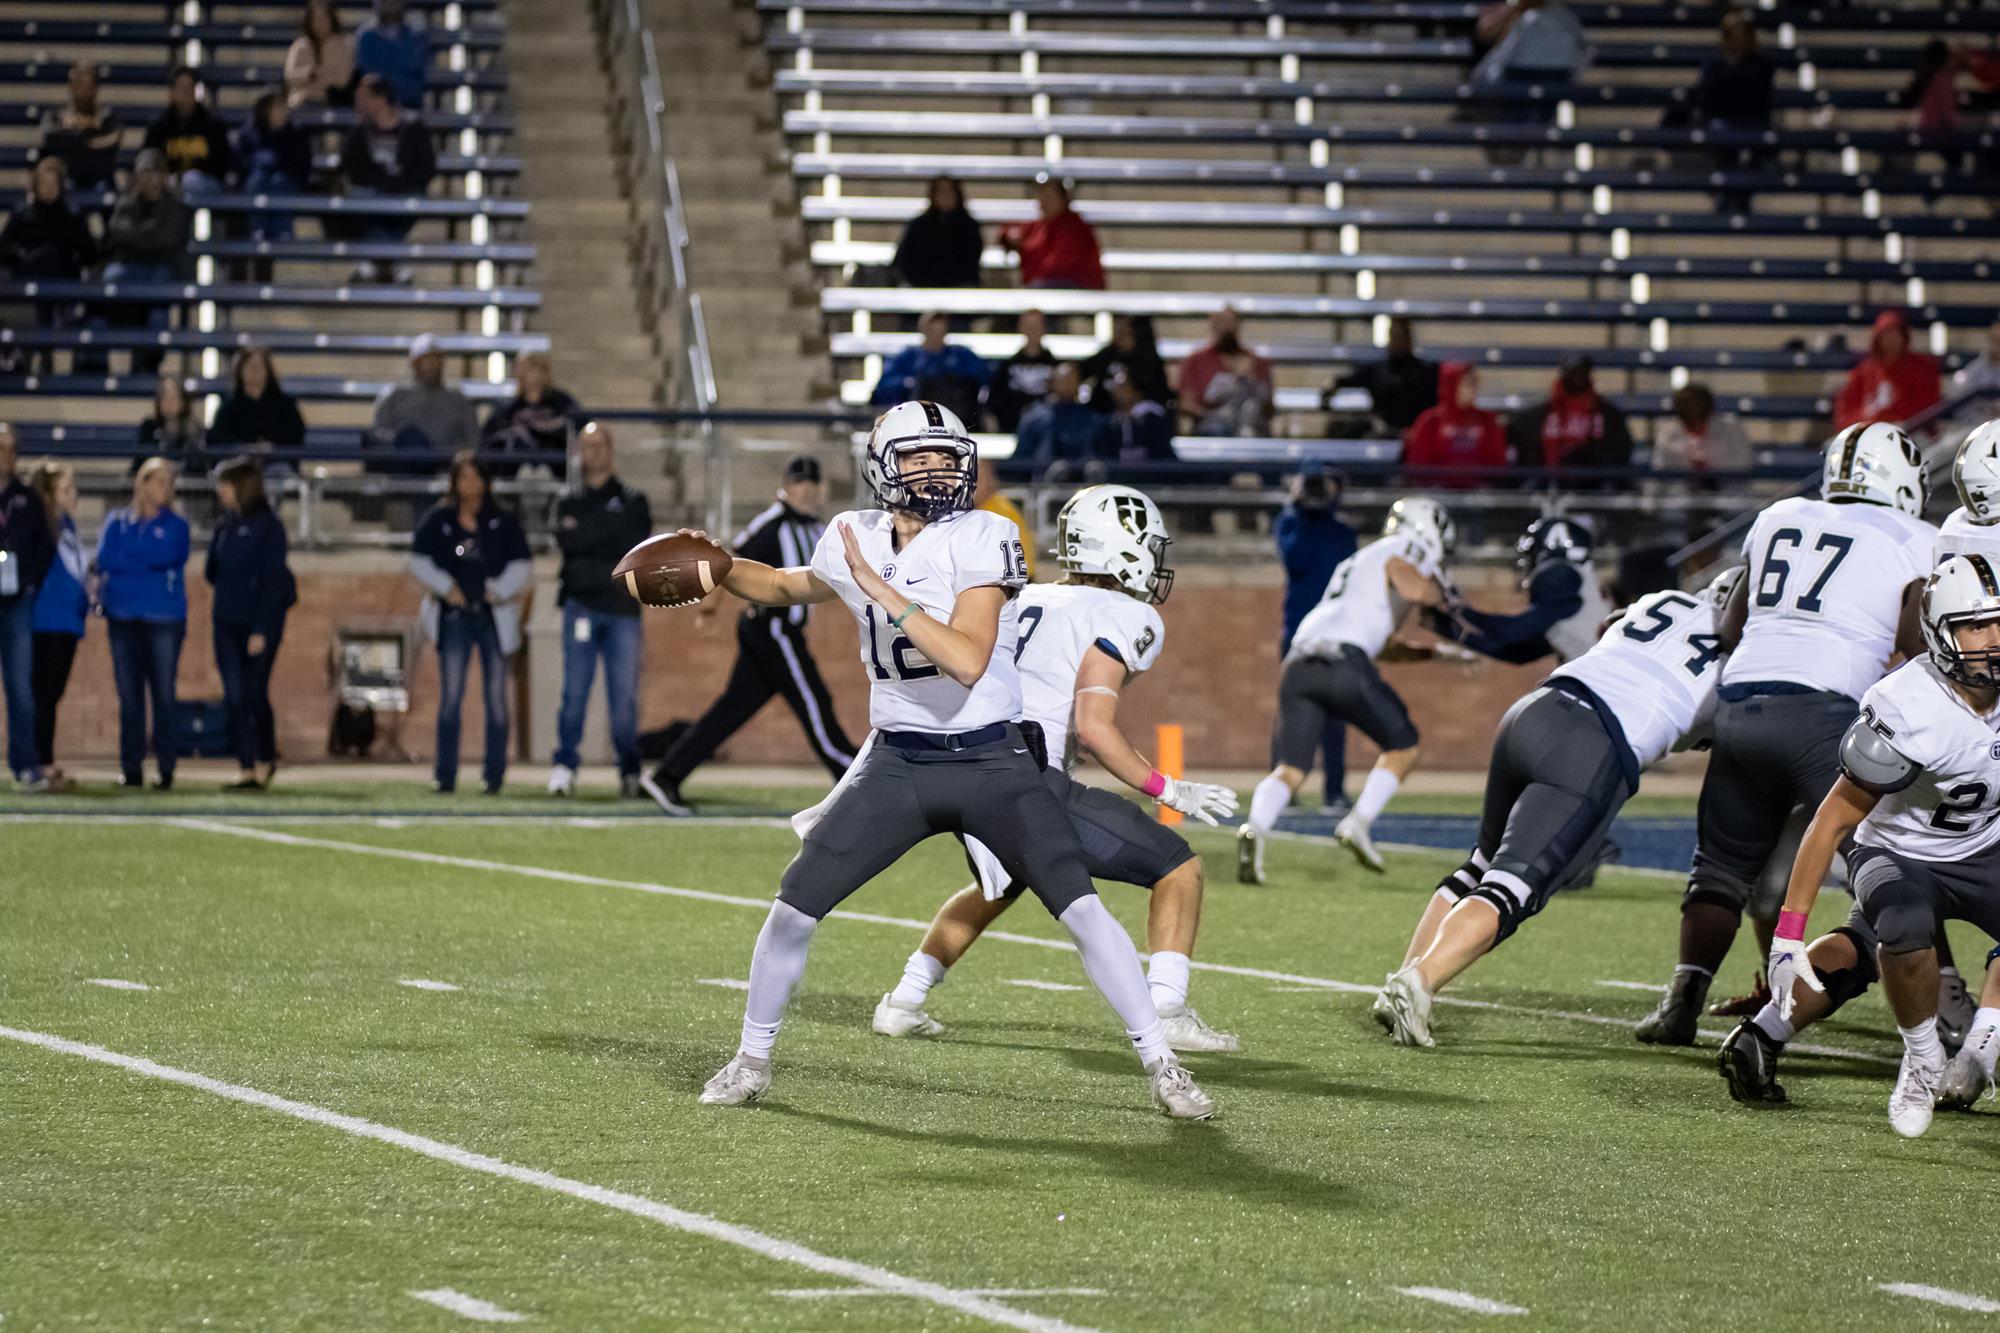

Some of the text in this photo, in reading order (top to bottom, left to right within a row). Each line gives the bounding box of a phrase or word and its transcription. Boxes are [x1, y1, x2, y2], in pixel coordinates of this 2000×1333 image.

[1000, 541, 1028, 579] 12
[1756, 528, 1854, 613] 67
[1133, 625, 1155, 659] 3
[1622, 595, 1722, 677] 54
[1929, 780, 2000, 832] 2
